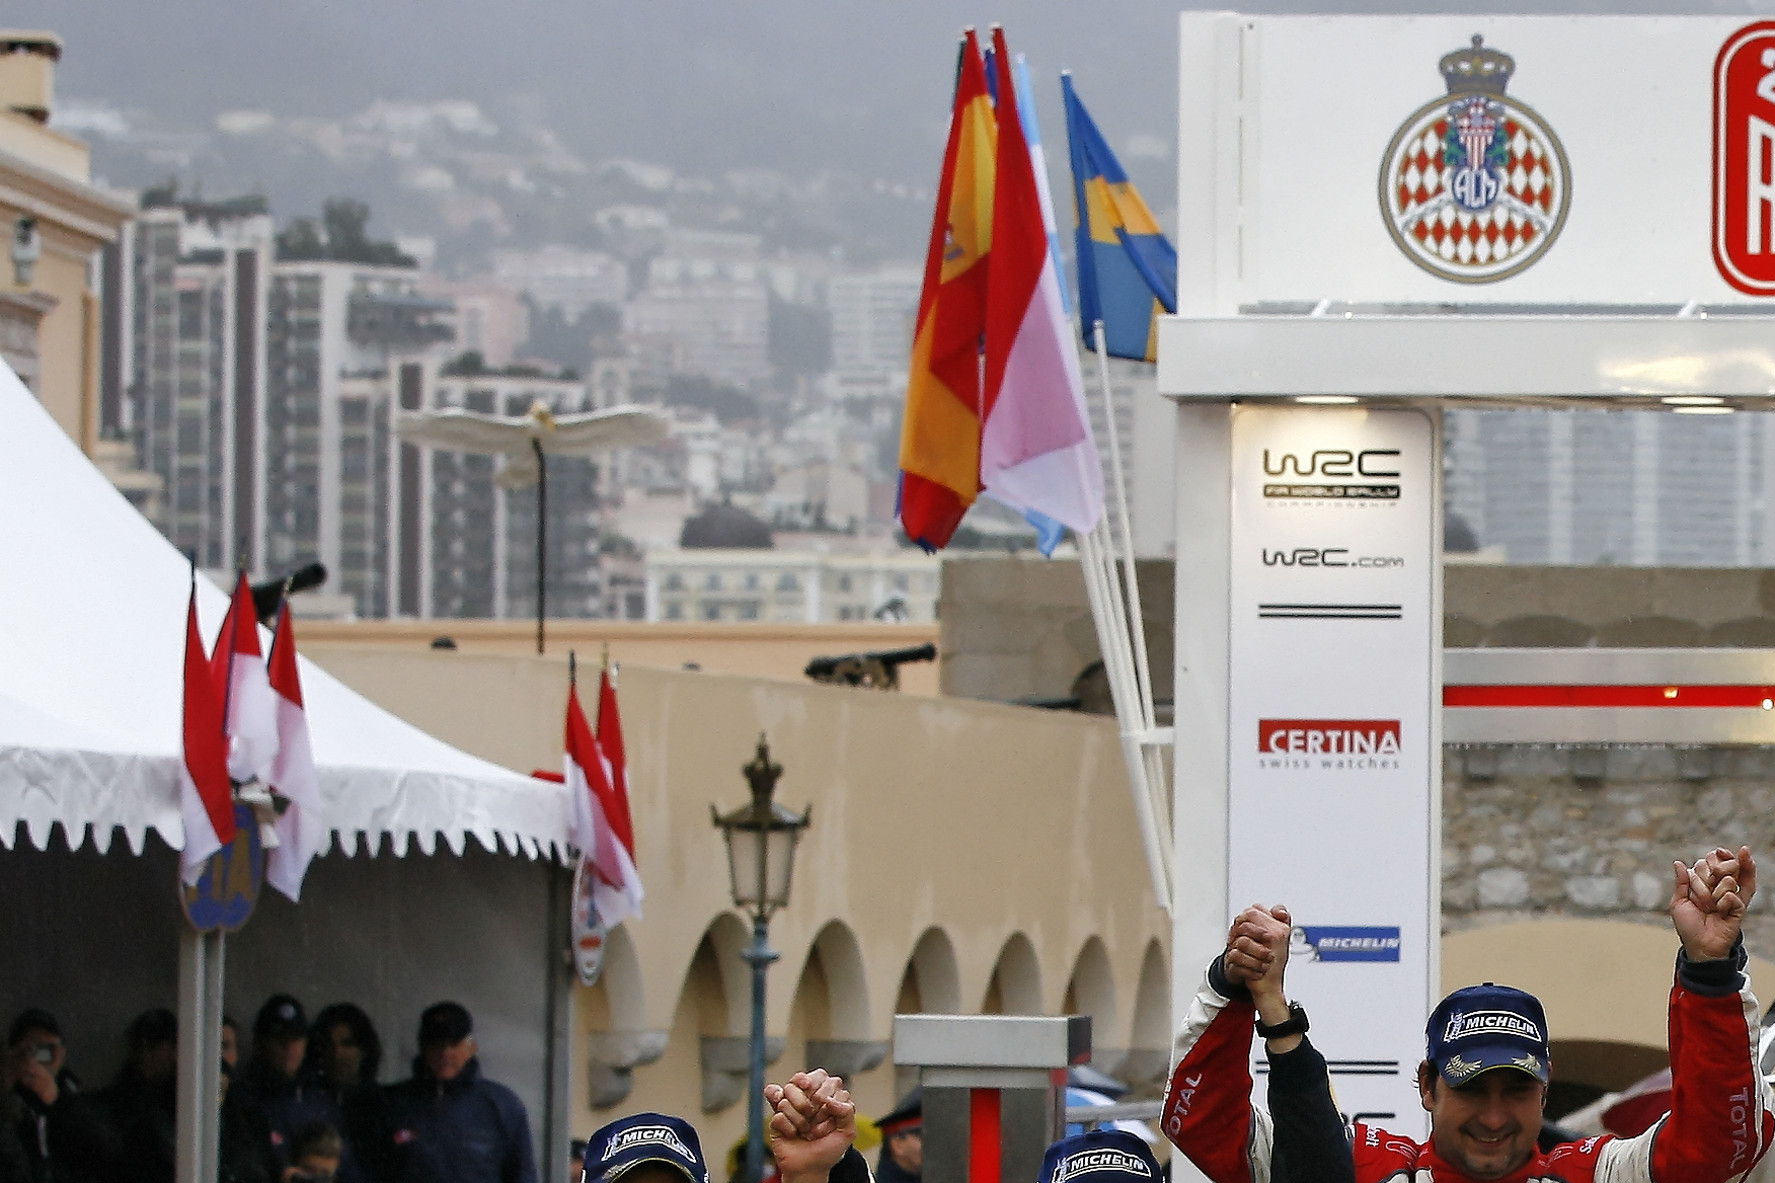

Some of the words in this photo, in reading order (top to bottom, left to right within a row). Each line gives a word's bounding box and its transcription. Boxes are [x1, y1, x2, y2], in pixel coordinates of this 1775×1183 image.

[1264, 449, 1400, 477] WRC
[1268, 730, 1399, 753] CERTINA
[1259, 757, 1310, 770] swiss
[1322, 756, 1399, 770] watches
[1318, 937, 1400, 949] MICHELIN
[1466, 1015, 1534, 1035] MICHELIN
[1169, 1073, 1202, 1136] OTAL
[1729, 1087, 1750, 1169] TOTAL
[1070, 1154, 1144, 1172] MICHELIN
